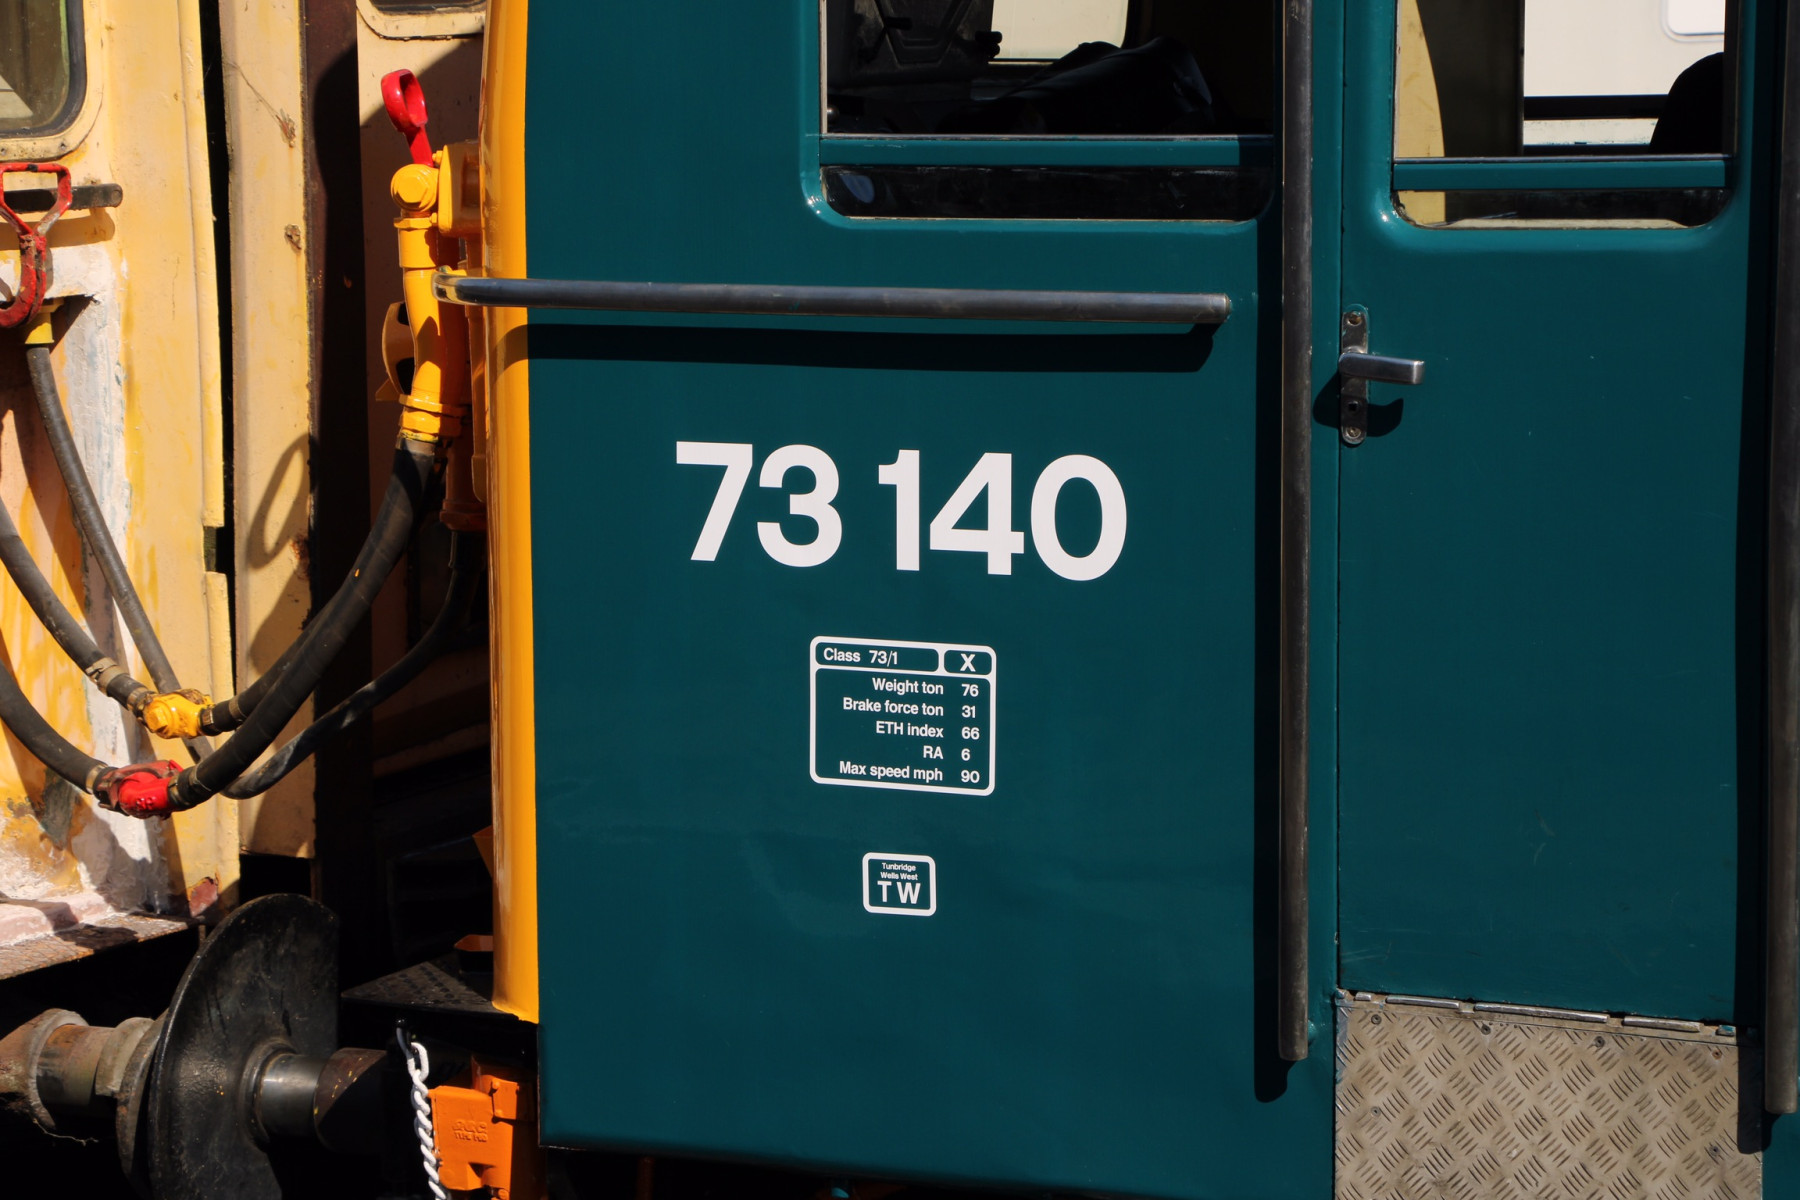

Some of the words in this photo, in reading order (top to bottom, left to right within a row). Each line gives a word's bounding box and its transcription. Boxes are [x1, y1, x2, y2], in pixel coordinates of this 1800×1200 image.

[676, 440, 843, 568] 73
[878, 449, 1127, 582] 140
[823, 647, 861, 663] Class
[868, 649, 898, 667] 73/1
[959, 653, 976, 673] X
[872, 677, 919, 695] Weight
[921, 681, 944, 695] ton
[961, 683, 979, 698] 76
[843, 696, 882, 713] Brake
[884, 699, 919, 715] force
[921, 702, 944, 717] ton
[961, 704, 976, 719] 31
[875, 720, 904, 735] ETH
[907, 722, 944, 738] index
[961, 726, 980, 741] 66
[923, 745, 944, 760] RA
[961, 747, 971, 762] 6
[839, 760, 867, 776] Max
[869, 765, 910, 780] speed
[913, 767, 943, 784] mph
[960, 769, 981, 784] 90
[880, 871, 899, 880] Wells
[900, 872, 918, 881] West
[881, 862, 917, 873] Tunbridge
